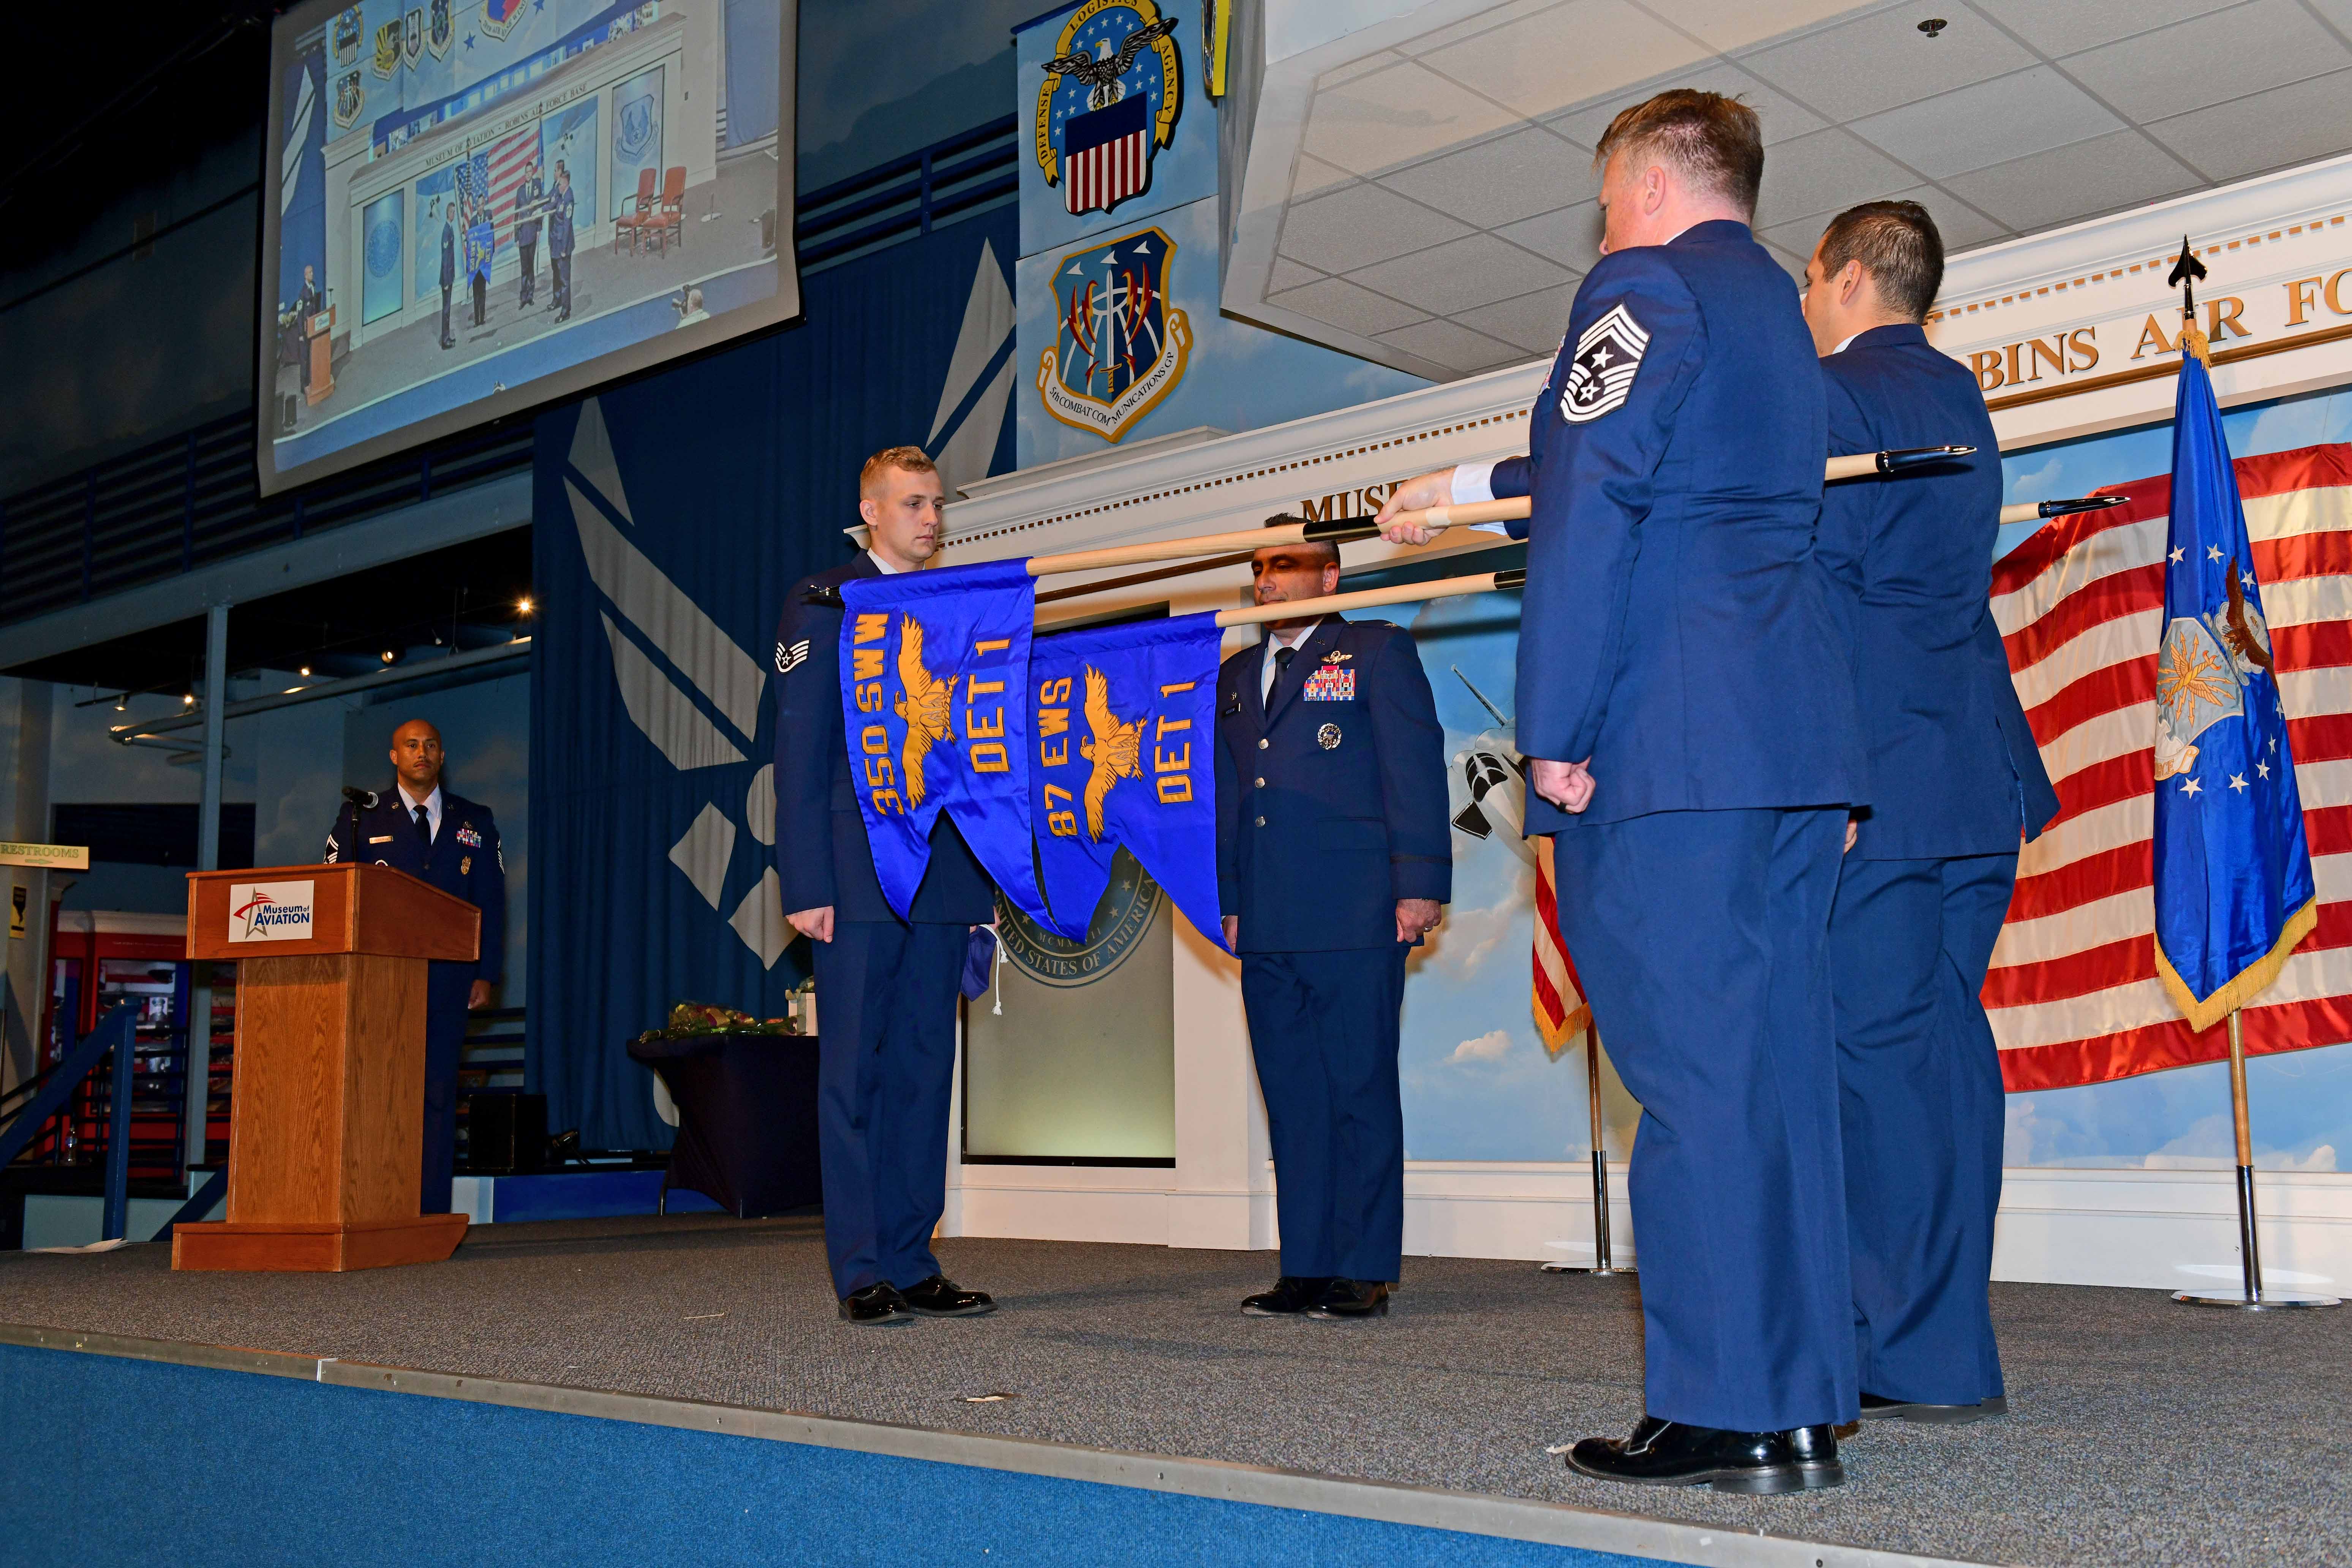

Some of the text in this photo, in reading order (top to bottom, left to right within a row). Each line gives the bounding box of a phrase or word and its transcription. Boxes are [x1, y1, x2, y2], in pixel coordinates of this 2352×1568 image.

[425, 149, 452, 167] MUSEUM
[455, 144, 463, 152] OF
[466, 128, 494, 148] VIATION
[546, 92, 568, 110] FORCE
[570, 84, 587, 96] BASE
[1038, 88, 1050, 160] DEFENSE
[1162, 44, 1174, 114] AGENCY
[1050, 386, 1060, 400] 5th
[1059, 397, 1092, 417] COMBAT
[1165, 352, 1174, 367] GP
[1954, 326, 2099, 392] BINS
[2129, 296, 2253, 360] AR
[852, 613, 904, 816] 350 SWW
[965, 638, 1011, 773] DET 1
[1154, 681, 1196, 804] DET 1
[1037, 677, 1078, 837] 87 EWS
[0, 844, 79, 858] RESTROOMS
[254, 912, 310, 926] AVIATION
[263, 905, 302, 914] Museum
[995, 878, 1155, 975] NITED STATES OF AMERICA
